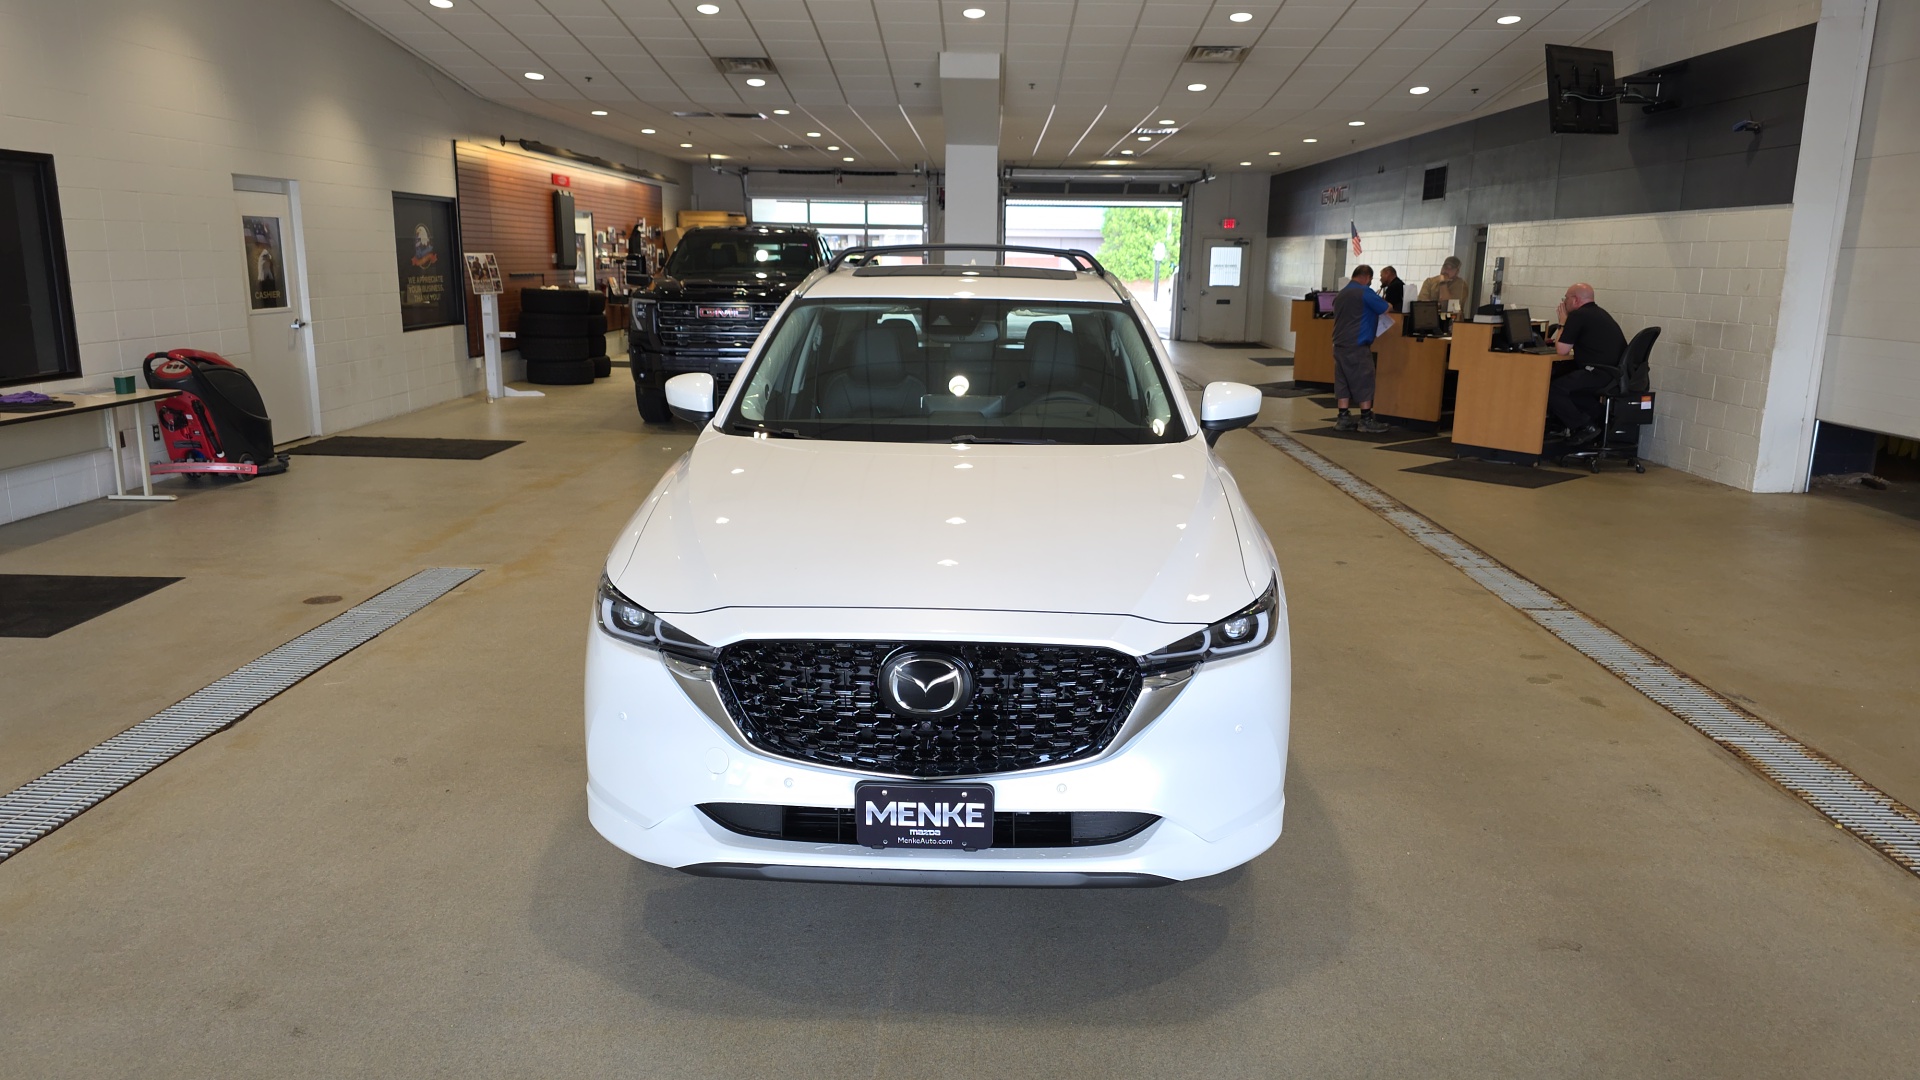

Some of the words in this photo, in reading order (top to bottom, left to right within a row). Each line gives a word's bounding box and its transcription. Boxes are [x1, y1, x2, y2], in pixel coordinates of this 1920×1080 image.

[1321, 185, 1349, 206] GMC
[254, 290, 281, 299] CASHIER
[699, 307, 750, 318] GMC
[865, 801, 985, 828] MENKE
[897, 836, 953, 845] MenkeAuto.com
